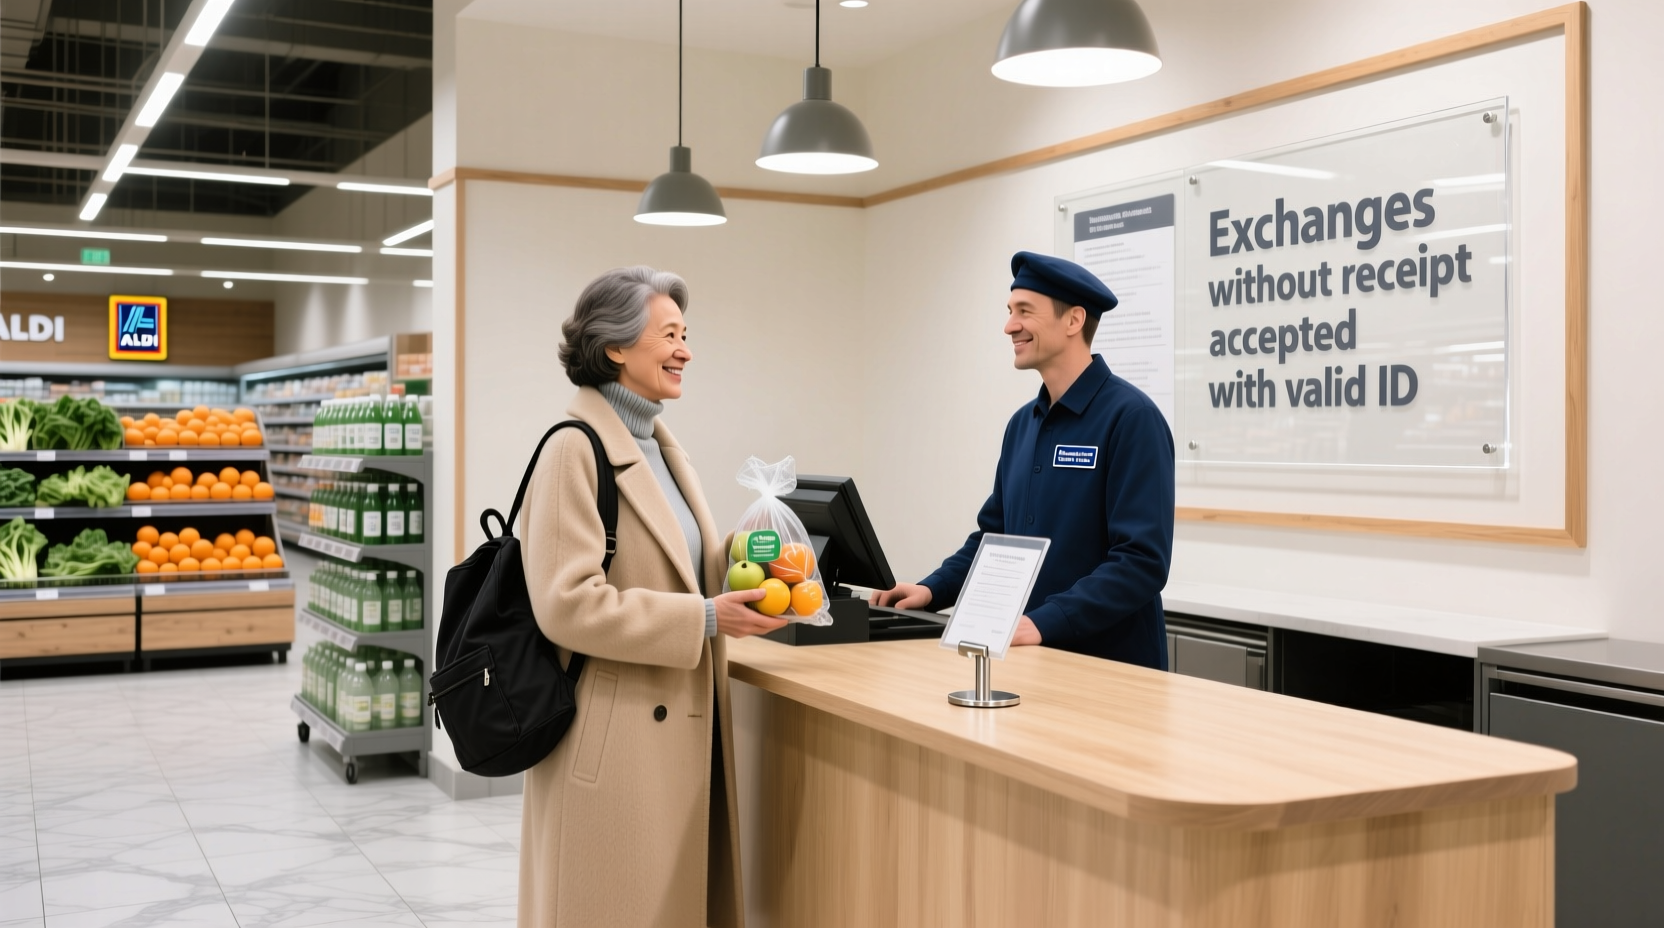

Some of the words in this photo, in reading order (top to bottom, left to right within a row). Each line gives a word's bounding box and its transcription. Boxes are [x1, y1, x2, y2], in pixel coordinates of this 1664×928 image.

[1209, 188, 1436, 257] Exchanges
[1208, 261, 1332, 308] without
[1342, 242, 1473, 298] receipt
[121, 334, 158, 347] ALDI
[1209, 308, 1357, 365] accepted
[1208, 368, 1276, 409] with
[1284, 364, 1366, 408] valid
[1378, 364, 1419, 407] ID
